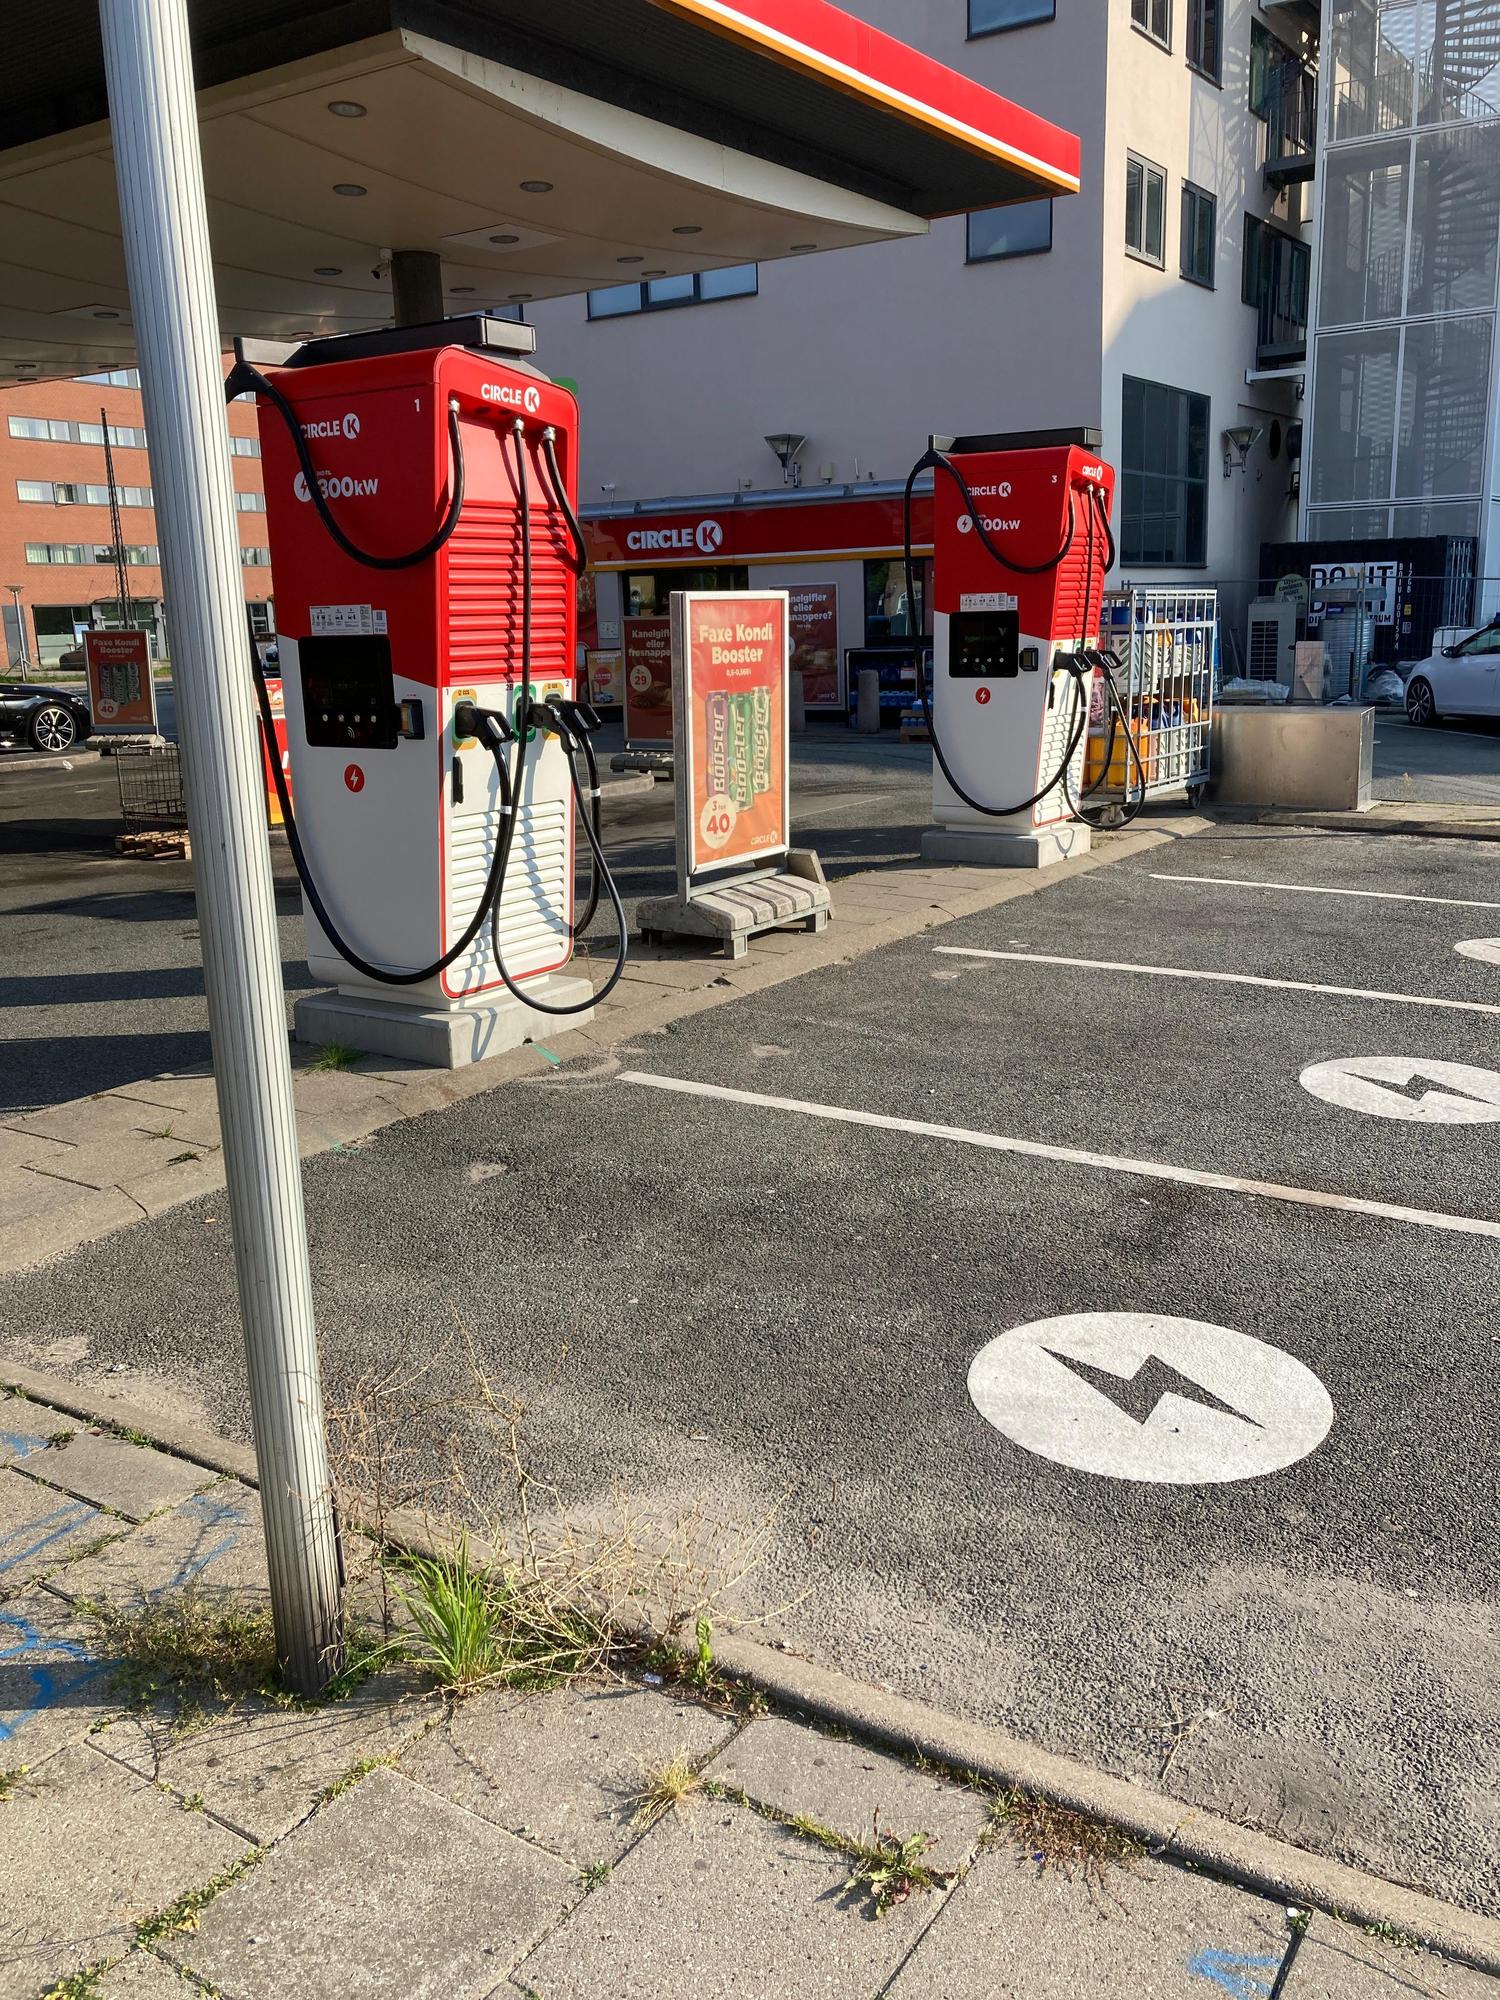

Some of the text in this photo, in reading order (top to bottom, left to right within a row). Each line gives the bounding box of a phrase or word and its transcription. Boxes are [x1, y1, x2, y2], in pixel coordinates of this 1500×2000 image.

[414, 398, 420, 412] 1
[481, 383, 540, 413] CIRCLE K
[342, 412, 360, 440] K
[1082, 465, 1096, 477] CIRCLE
[1051, 475, 1058, 484] 3
[998, 481, 1012, 497] K
[626, 519, 724, 553] CIRCLE K
[793, 603, 813, 612] eller
[699, 622, 773, 643] Faxe Kondi
[711, 646, 763, 665] Booster
[565, 679, 570, 687] 2
[635, 675, 647, 685] 29
[100, 705, 114, 713] 40
[712, 800, 717, 811] 3
[706, 813, 730, 833] 40
